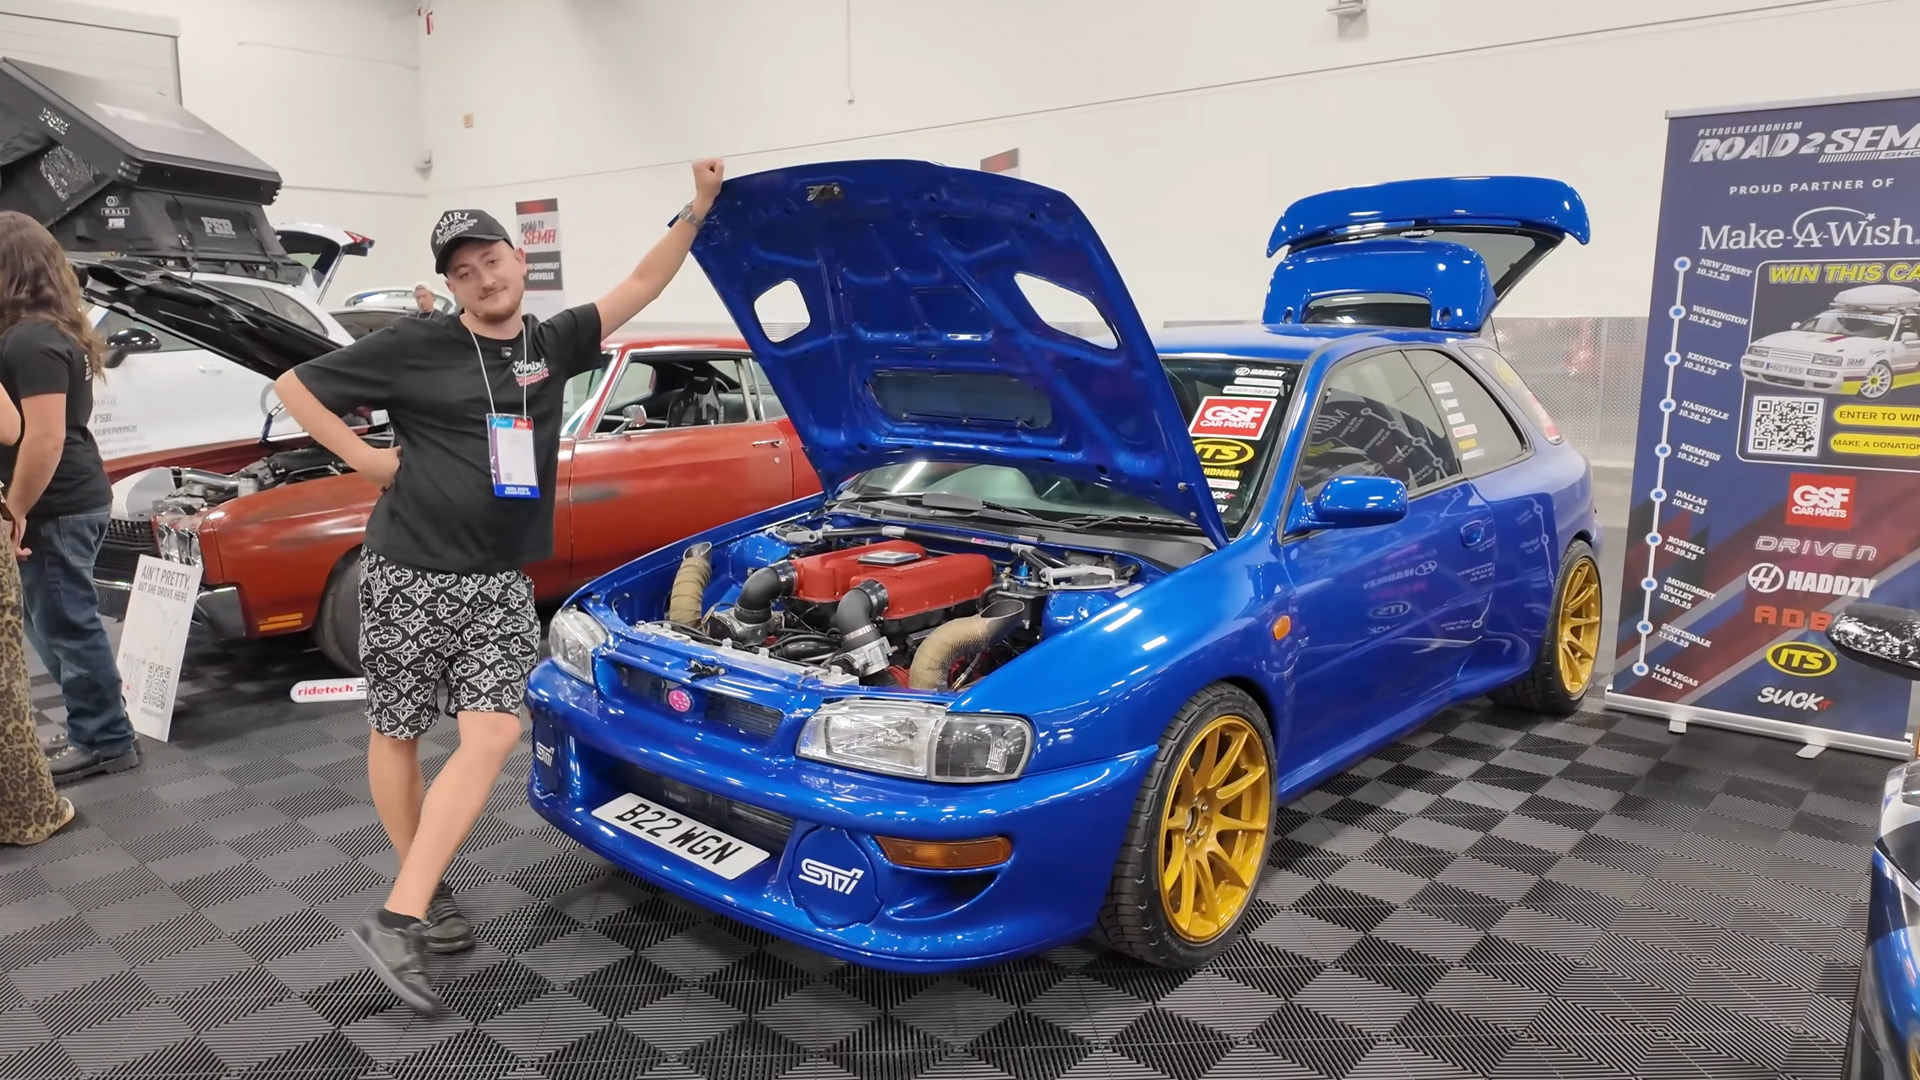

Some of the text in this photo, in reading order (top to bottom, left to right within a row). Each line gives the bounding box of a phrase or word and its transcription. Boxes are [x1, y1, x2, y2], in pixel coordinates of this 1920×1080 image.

[1698, 121, 1803, 137] PETROLHEADONISM
[1690, 123, 1920, 162] ROAD 2 SEM
[1729, 177, 1894, 195] PROUD PARTNER OF
[200, 216, 236, 236] FSR
[435, 211, 469, 239] AMIRI
[523, 228, 557, 246] SEMA
[1696, 267, 1731, 282] 10.23.25
[1699, 258, 1753, 277] NEW JERSEY
[1769, 264, 1821, 284] WIN
[1825, 262, 1884, 284] THIS
[1688, 314, 1722, 328] 10.24.25
[1692, 304, 1749, 326] WASHINGTON
[1683, 361, 1717, 376] 10.25.25
[1686, 352, 1732, 370] KENTUCKY
[1204, 405, 1264, 423] GSF
[1678, 409, 1712, 425] 10.26.25
[1681, 400, 1730, 420] NASHVILLE
[1839, 410, 1877, 420] ENTER
[1881, 412, 1896, 421] TO
[1200, 420, 1257, 429] CAR PARTS
[1833, 439, 1861, 447] MAKE
[1676, 451, 1710, 467] 10.27.25
[1680, 443, 1721, 462] MEMPHIS
[1675, 490, 1708, 506] DALLAS
[1793, 485, 1850, 509] GSF
[1671, 498, 1705, 515] 10.28.25
[1791, 506, 1847, 518] CAR PARTS
[1667, 535, 1706, 555] ROSWELL
[1755, 535, 1878, 561] DRIVEN
[141, 564, 191, 591] AIN'T PRETTY,
[1786, 570, 1878, 598] HADDZY
[137, 581, 188, 603] BUT SHE DROVE HERE
[1663, 584, 1695, 601] VALLEY
[1666, 577, 1717, 600] MONUMENT
[1659, 593, 1692, 610] 10.30.25
[1658, 631, 1690, 648] 11.01.25
[1661, 623, 1712, 648] SCOTTSDALE
[1778, 648, 1824, 670] ITS
[1651, 672, 1684, 690] 11.02.25
[1654, 664, 1699, 687] LAS VEGAS
[298, 684, 353, 696] ridetech
[615, 803, 743, 866] B22 WGN
